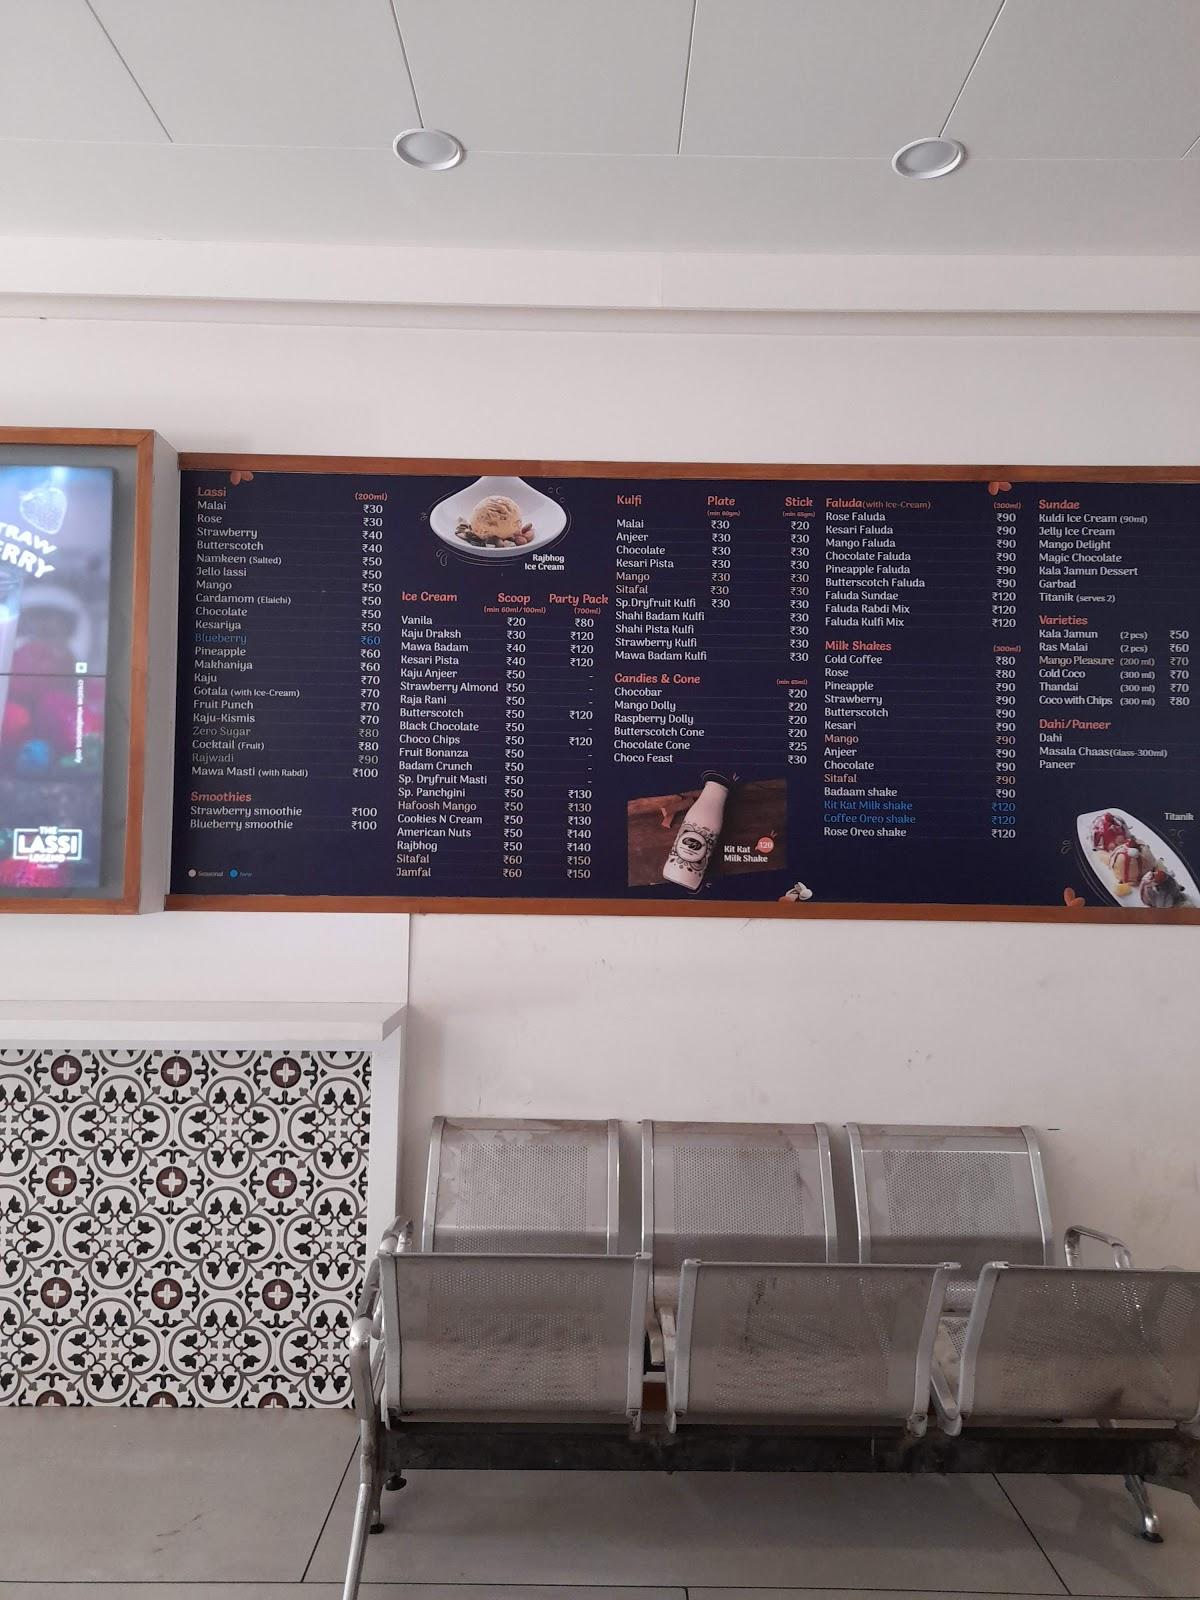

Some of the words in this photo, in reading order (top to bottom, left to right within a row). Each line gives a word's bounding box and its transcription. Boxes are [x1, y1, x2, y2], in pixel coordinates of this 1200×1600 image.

[198, 486, 226, 497] Lassi
[198, 501, 226, 510] Malai
[617, 495, 641, 507] Kulfi
[708, 496, 735, 506] Plate
[785, 497, 813, 507] Stick
[1039, 499, 1080, 509] Sundae
[363, 504, 383, 513] ₹30
[826, 512, 850, 521] Rose
[852, 512, 886, 521] Faluda
[997, 513, 1016, 522] ₹90
[1039, 513, 1064, 522] Kuldi
[1067, 514, 1082, 522] Ice
[1083, 514, 1117, 523] Cream
[197, 527, 258, 540] Strawberry
[1039, 526, 1062, 538] Jelly
[1065, 527, 1080, 536] Ice
[1081, 527, 1115, 536] Cream
[616, 532, 649, 543] Anjeer
[197, 540, 264, 550] Butterscotch
[826, 538, 860, 550] Mango
[862, 538, 896, 547] Faluda
[1039, 540, 1074, 551] Mango
[1076, 540, 1111, 551] Delight
[197, 554, 246, 563] Namkeen
[362, 557, 382, 566] ₹50
[532, 554, 565, 563] Rajbhog
[1039, 553, 1070, 564] Magic
[1071, 553, 1122, 562] Chocolate
[196, 566, 221, 576] Jello
[1039, 566, 1061, 575] Kala
[1063, 566, 1098, 575] Jamun
[1100, 566, 1138, 576] Dessert
[1039, 579, 1076, 588] Garbad
[196, 593, 255, 603] Cardamom
[402, 591, 417, 601] Ice
[421, 591, 457, 601] Cream
[498, 593, 530, 605] Scoop
[549, 593, 579, 606] Party
[583, 594, 608, 604] Pack
[825, 590, 859, 600] Faluda
[861, 591, 899, 600] Sundae
[1039, 592, 1074, 601] Titanik
[674, 598, 696, 607] Kulfi
[196, 606, 248, 617] Chocolate
[615, 611, 643, 620] Shahi
[646, 611, 680, 620] Badam
[682, 612, 704, 621] Kulfi
[401, 615, 433, 625] Vanila
[507, 617, 526, 626] ₹20
[575, 618, 594, 627] ₹80
[825, 617, 859, 626] Faluda
[861, 617, 884, 626] Kulfi
[886, 618, 904, 626] Mix
[1039, 615, 1088, 625] Varieties
[196, 620, 242, 632] Kesariya
[401, 628, 423, 640] Kaju
[426, 629, 461, 638] Draksh
[570, 631, 594, 640] ₹120
[1039, 629, 1061, 638] Kala
[1063, 629, 1098, 638] Jamun
[825, 640, 849, 650] Milk
[852, 640, 892, 651] Shakes
[195, 646, 246, 658] Pineapple
[401, 655, 432, 664] Kesari
[435, 656, 459, 665] Pista
[825, 654, 847, 664] Cold
[849, 654, 882, 664] Coffee
[195, 659, 253, 672] Makhaniya
[194, 673, 217, 685] Kaju
[361, 675, 380, 685] ₹70
[615, 673, 658, 683] Candies
[661, 674, 670, 683] &
[673, 674, 700, 684] Cone
[194, 686, 228, 696] Gotala
[400, 681, 458, 694] Strawberry
[460, 682, 498, 692] Almond
[614, 687, 662, 696] Chocobar
[1039, 682, 1078, 691] Thandai
[194, 699, 218, 709] Fruit
[221, 700, 253, 709] Punch
[400, 694, 422, 706] Raja
[425, 695, 446, 704] Rani
[1039, 695, 1063, 704] Coco
[1064, 695, 1085, 704] with
[1086, 696, 1113, 707] Chips
[615, 700, 648, 712] Mango
[651, 701, 676, 712] Dolly
[193, 713, 256, 724] Kaju-Kismis
[614, 713, 666, 725] Raspberry
[668, 714, 694, 726] Dolly
[1039, 719, 1111, 730] Dahi/Paneer
[1039, 733, 1062, 742] Dahi
[192, 739, 235, 749] Cocktail
[614, 753, 645, 762] Choco
[647, 753, 673, 762] Feast
[1039, 760, 1076, 769] Paneer
[192, 766, 224, 776] Mawa
[227, 767, 255, 776] Masti
[353, 768, 378, 777] ₹100
[191, 791, 252, 802] Smoothies
[824, 787, 865, 796] Badaam
[867, 787, 898, 797] shake
[398, 800, 440, 810] Hafoosh
[443, 801, 477, 813] Mango
[191, 806, 252, 818] Strawberry
[254, 806, 302, 816] smoothie
[1164, 812, 1194, 820] Titanik
[397, 814, 437, 823] Cookies
[439, 814, 446, 823] N
[449, 814, 482, 824] Cream
[190, 819, 242, 831] Blueberry
[245, 820, 293, 829] smoothie
[397, 827, 446, 837] American
[448, 828, 471, 837] Nuts
[824, 827, 848, 836] Rose
[850, 827, 875, 836] Oreo
[877, 827, 907, 837] shake
[18, 834, 78, 854] LASSI
[724, 845, 735, 853] Kit
[737, 845, 750, 853] Kat
[760, 841, 773, 849] 120
[396, 854, 429, 863] Sitafal
[724, 854, 742, 862] Milk
[743, 854, 768, 862] Shake
[396, 867, 431, 877] Jamfal
[503, 868, 522, 878] ₹60
[567, 869, 591, 878] ₹150
